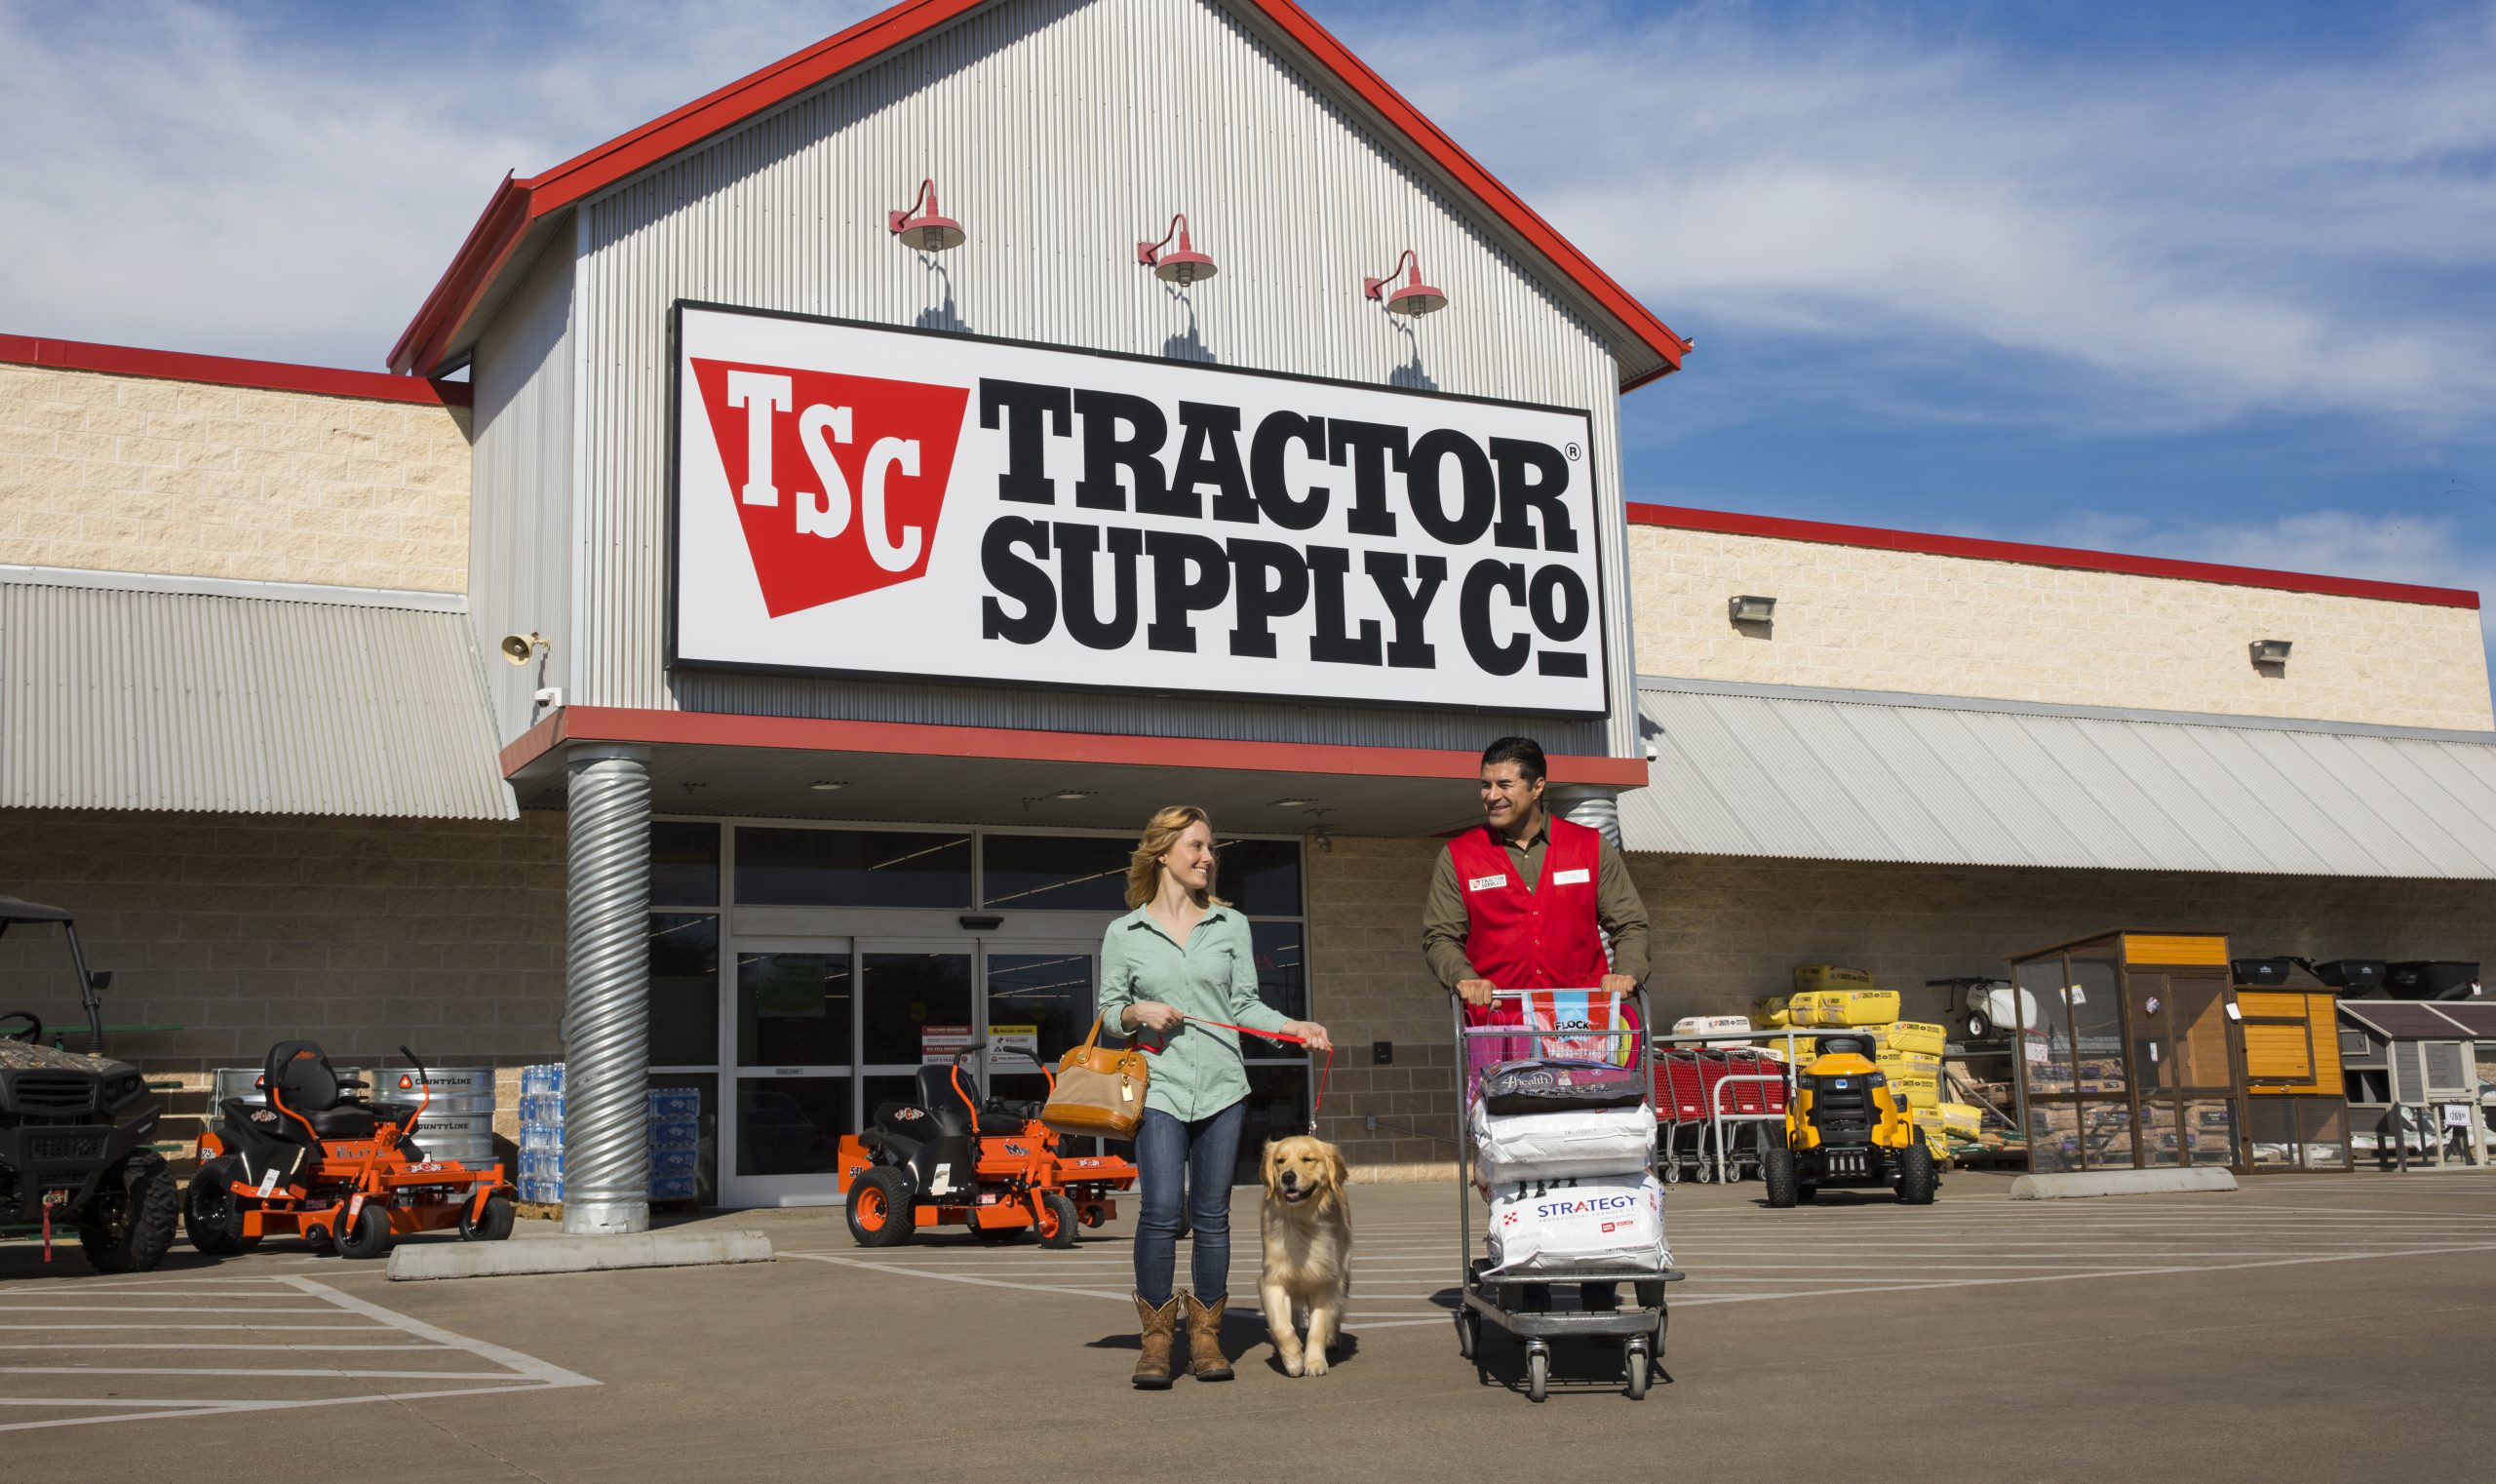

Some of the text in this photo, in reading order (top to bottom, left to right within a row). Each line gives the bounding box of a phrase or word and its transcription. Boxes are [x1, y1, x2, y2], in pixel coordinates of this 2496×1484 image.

[727, 370, 923, 573] TSC
[979, 376, 1578, 554] TRACTOR
[980, 515, 1448, 670] SUPPLY
[1554, 1020, 1590, 1031] FLOCK
[1502, 1074, 1548, 1089] 4health
[1538, 1195, 1638, 1218] STRATEGY
